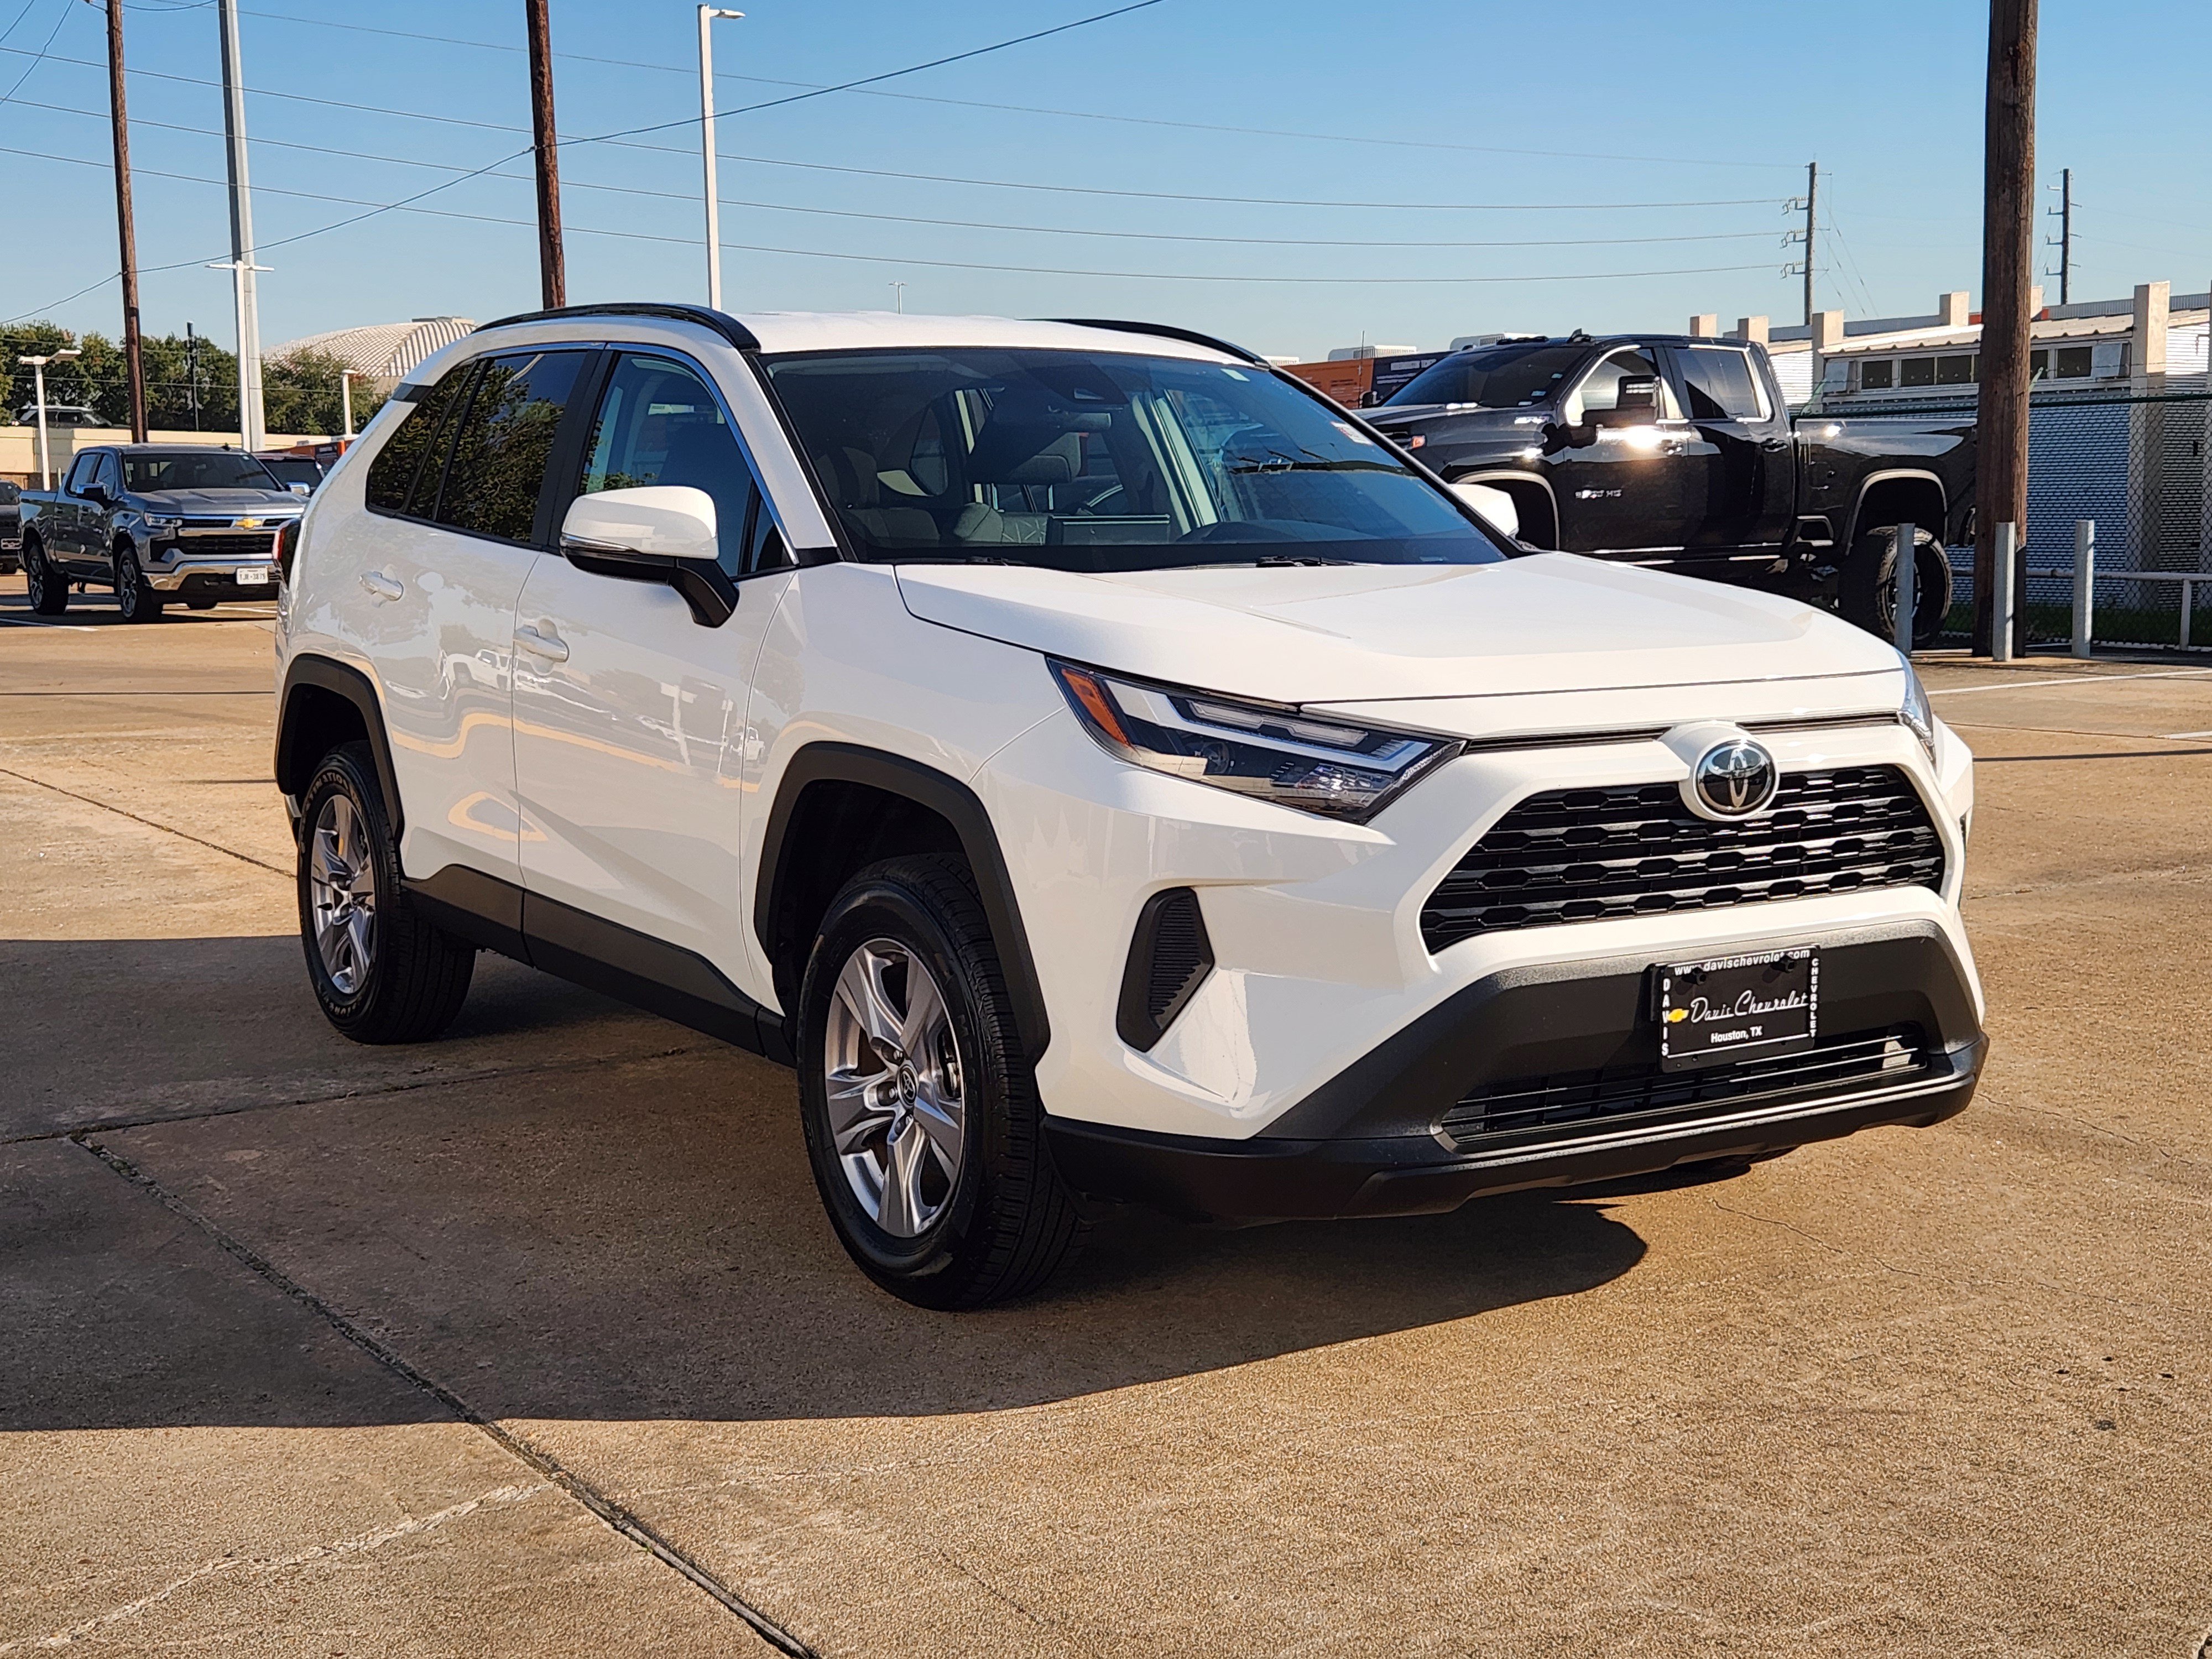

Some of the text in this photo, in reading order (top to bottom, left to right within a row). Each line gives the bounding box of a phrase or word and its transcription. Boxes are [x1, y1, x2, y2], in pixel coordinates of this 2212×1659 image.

[1661, 978, 1671, 1056] DAVIS
[1691, 990, 1808, 1023] Davis Chevrolet
[1810, 958, 1819, 1038] CHEVROLET
[1711, 1026, 1763, 1044] Houston, TX
